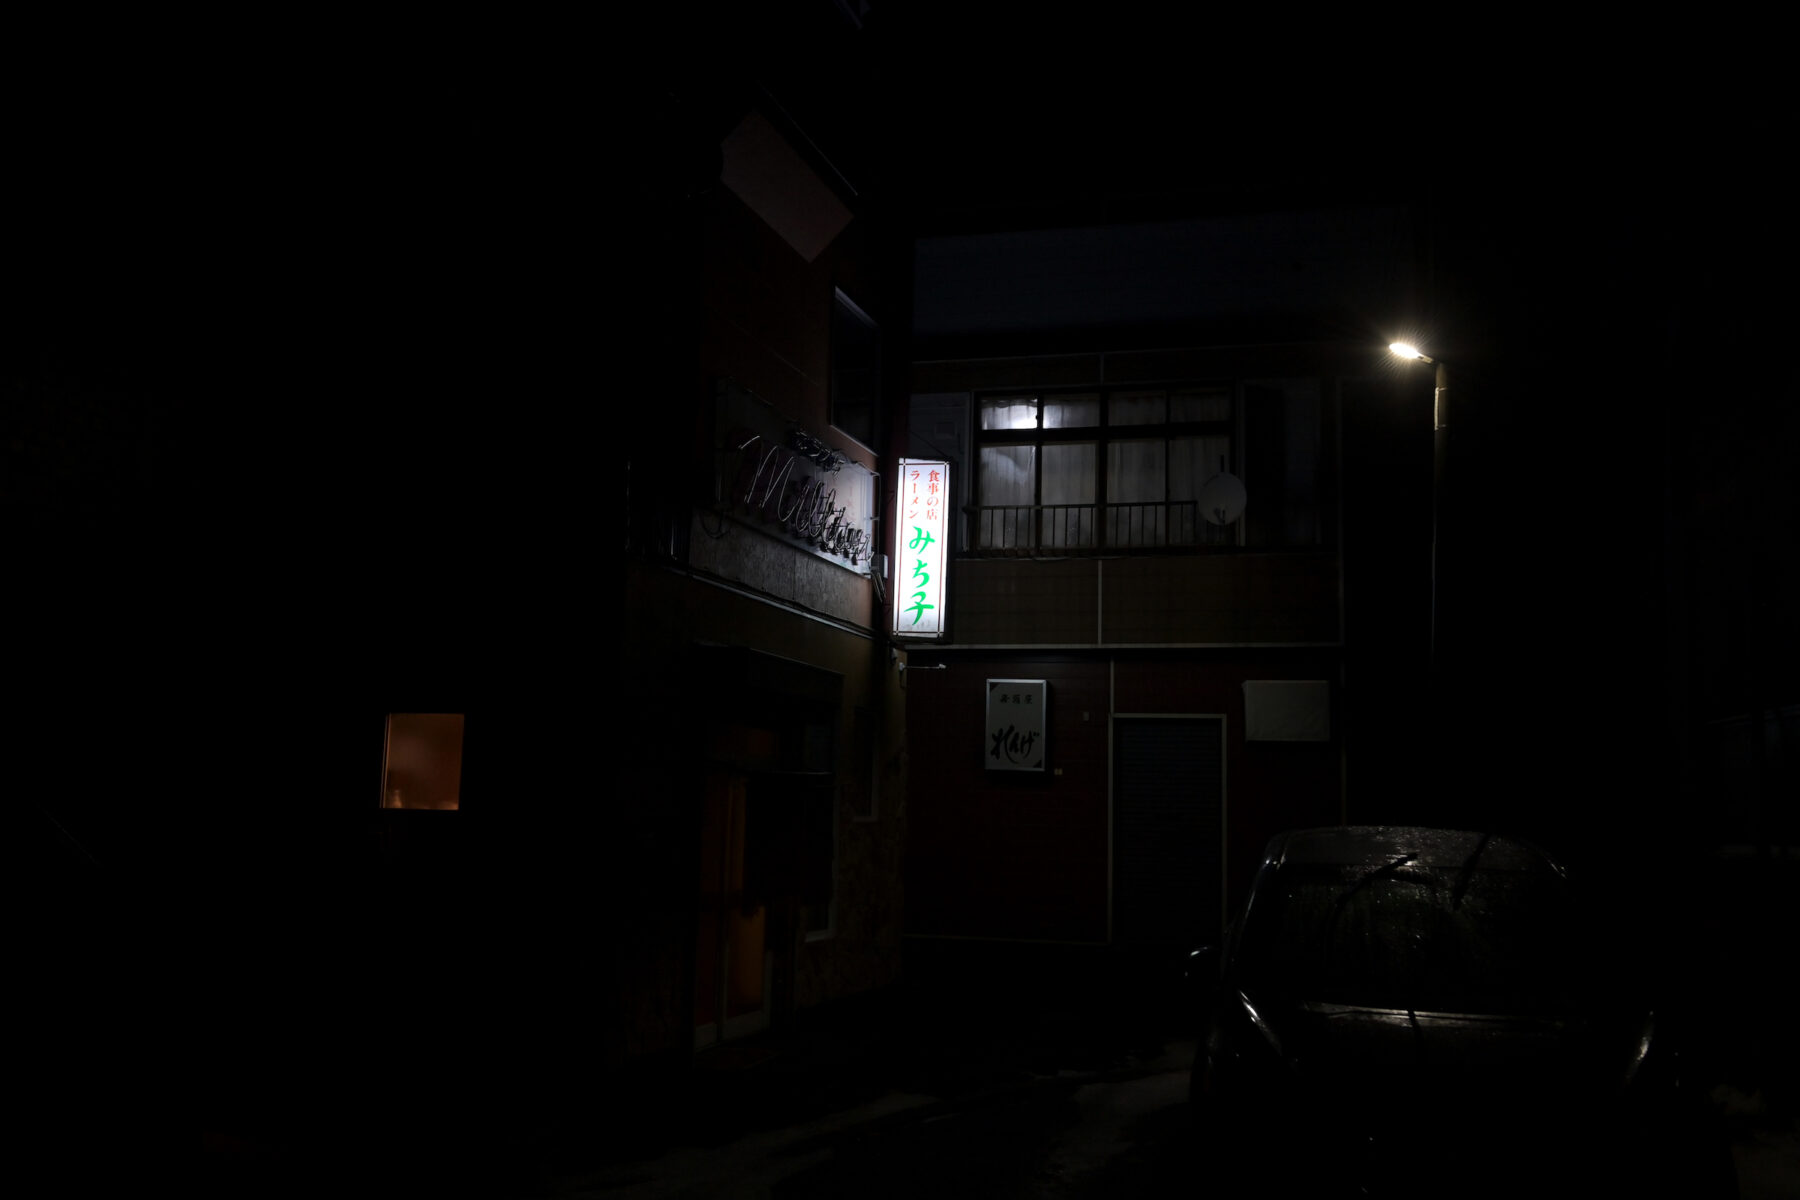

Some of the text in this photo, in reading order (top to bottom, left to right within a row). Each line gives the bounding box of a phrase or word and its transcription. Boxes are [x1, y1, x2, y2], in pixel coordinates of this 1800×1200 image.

[909, 470, 921, 520] ラーメン
[926, 468, 941, 521] 食事の店
[904, 525, 937, 626] みち子
